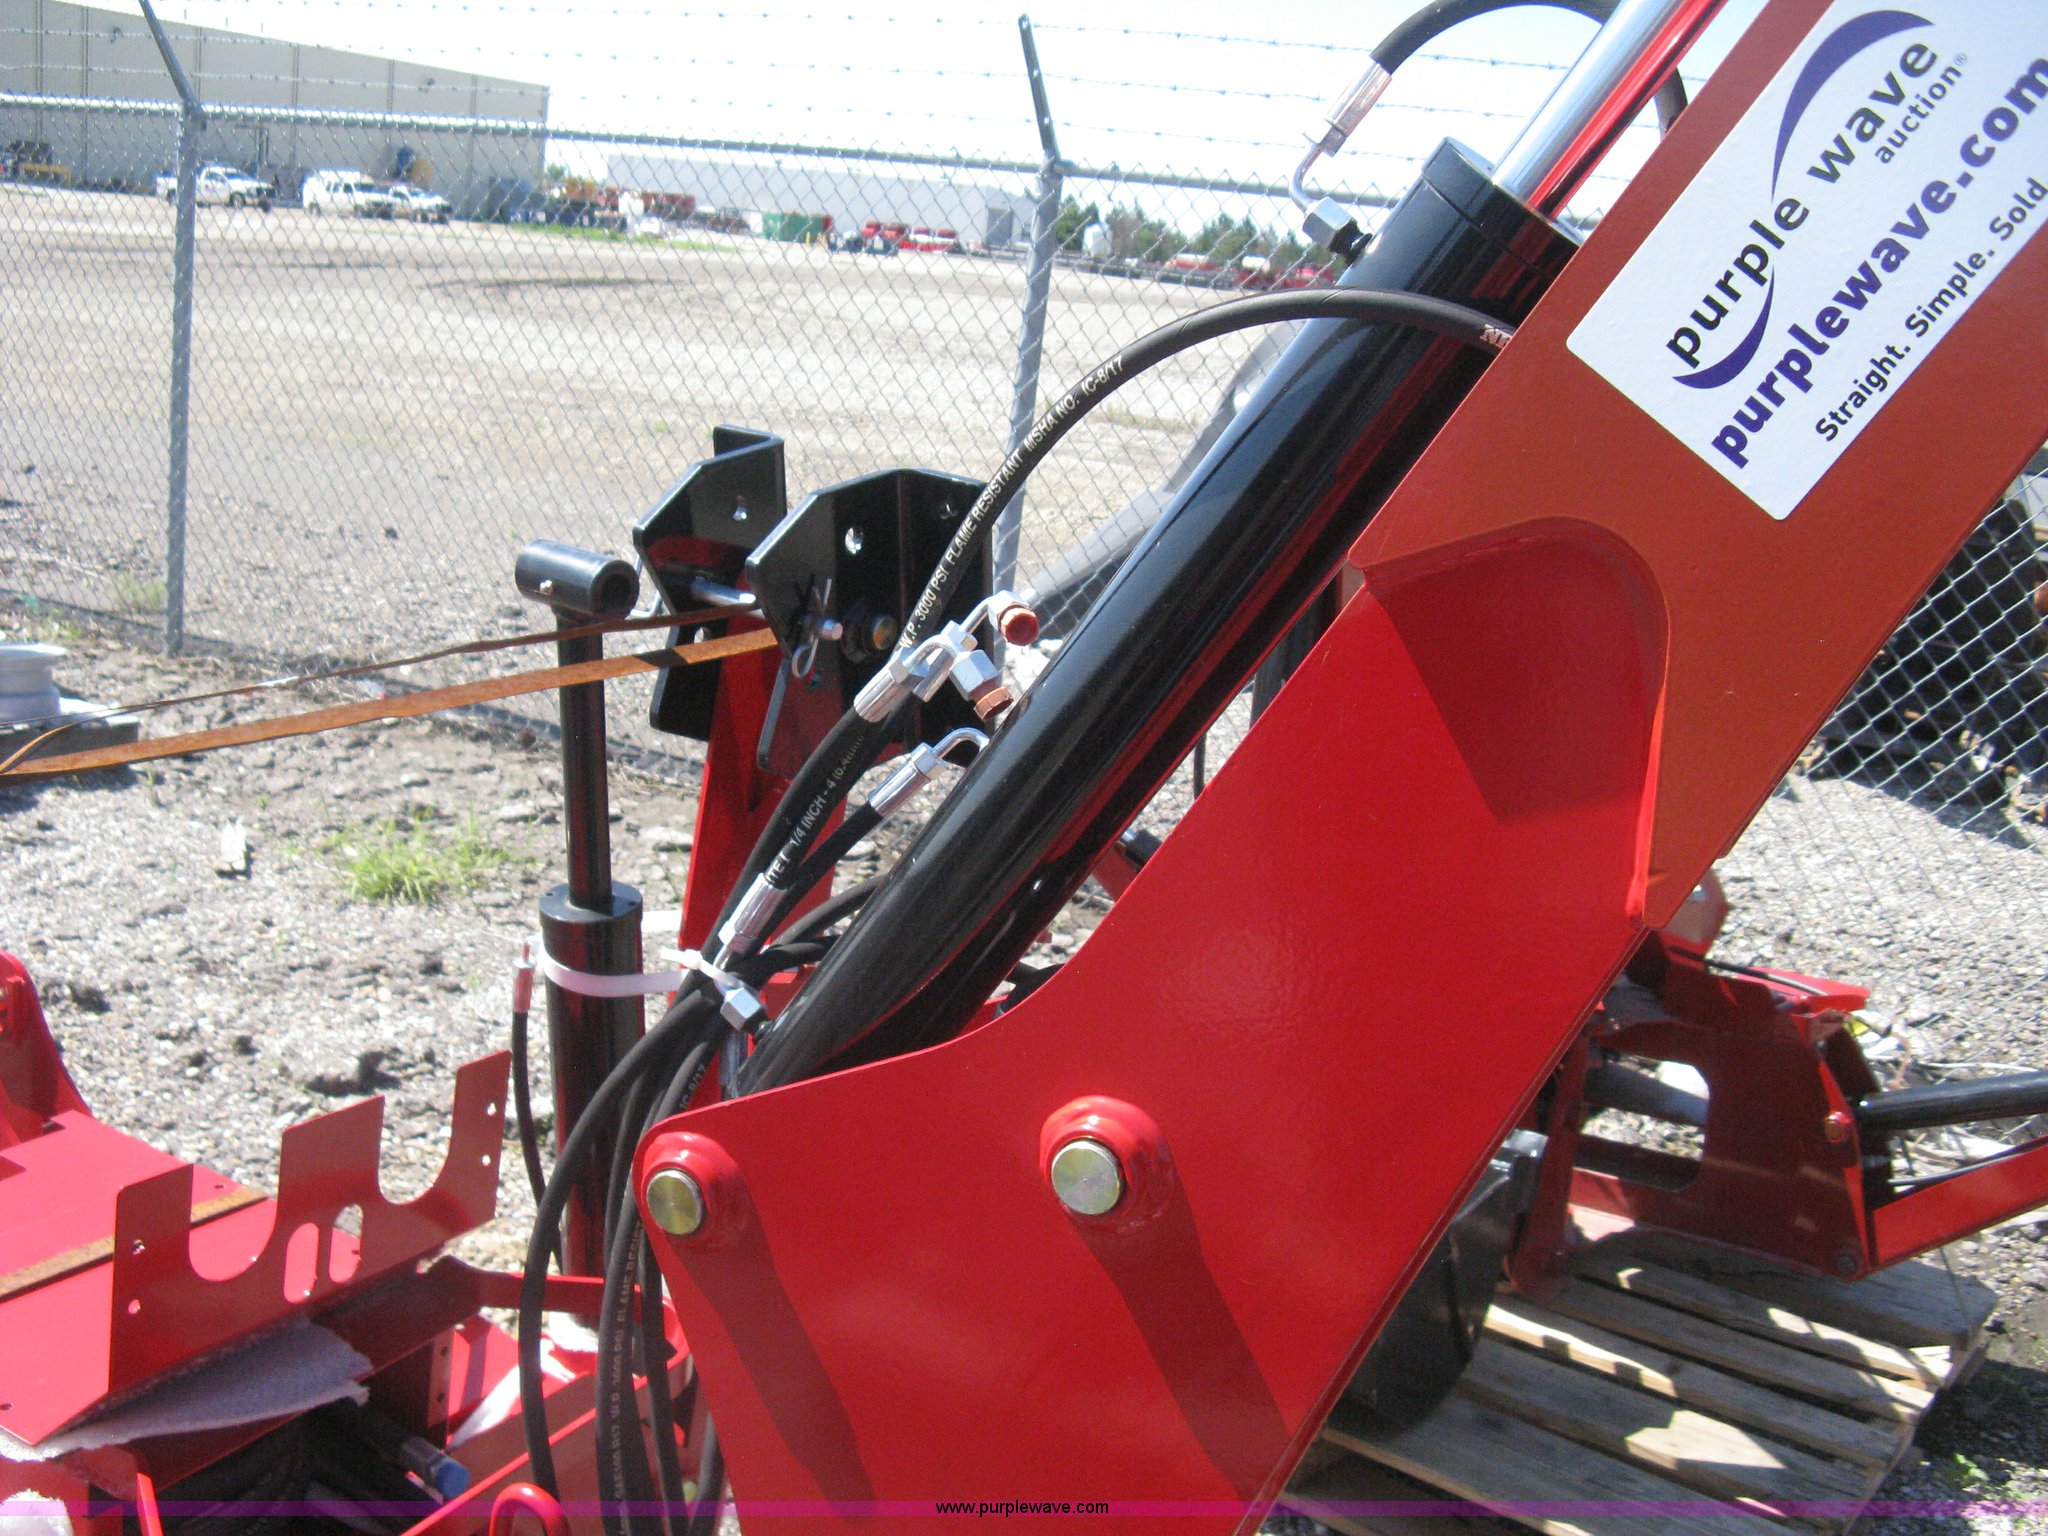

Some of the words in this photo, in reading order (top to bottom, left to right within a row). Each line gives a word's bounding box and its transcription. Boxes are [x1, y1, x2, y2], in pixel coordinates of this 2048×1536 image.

[1666, 197, 1809, 369] purple
[1807, 42, 1938, 184] wave
[1711, 57, 2048, 469] purplewave.com
[1815, 345, 1912, 442] Straight.
[1905, 249, 1996, 339] Simple.
[915, 588, 937, 621] 3000
[930, 565, 949, 591] PSI
[945, 517, 977, 565] FLAME
[972, 448, 1023, 521] RESISTANT
[1023, 413, 1058, 452] MSHA
[801, 795, 827, 829] INCH
